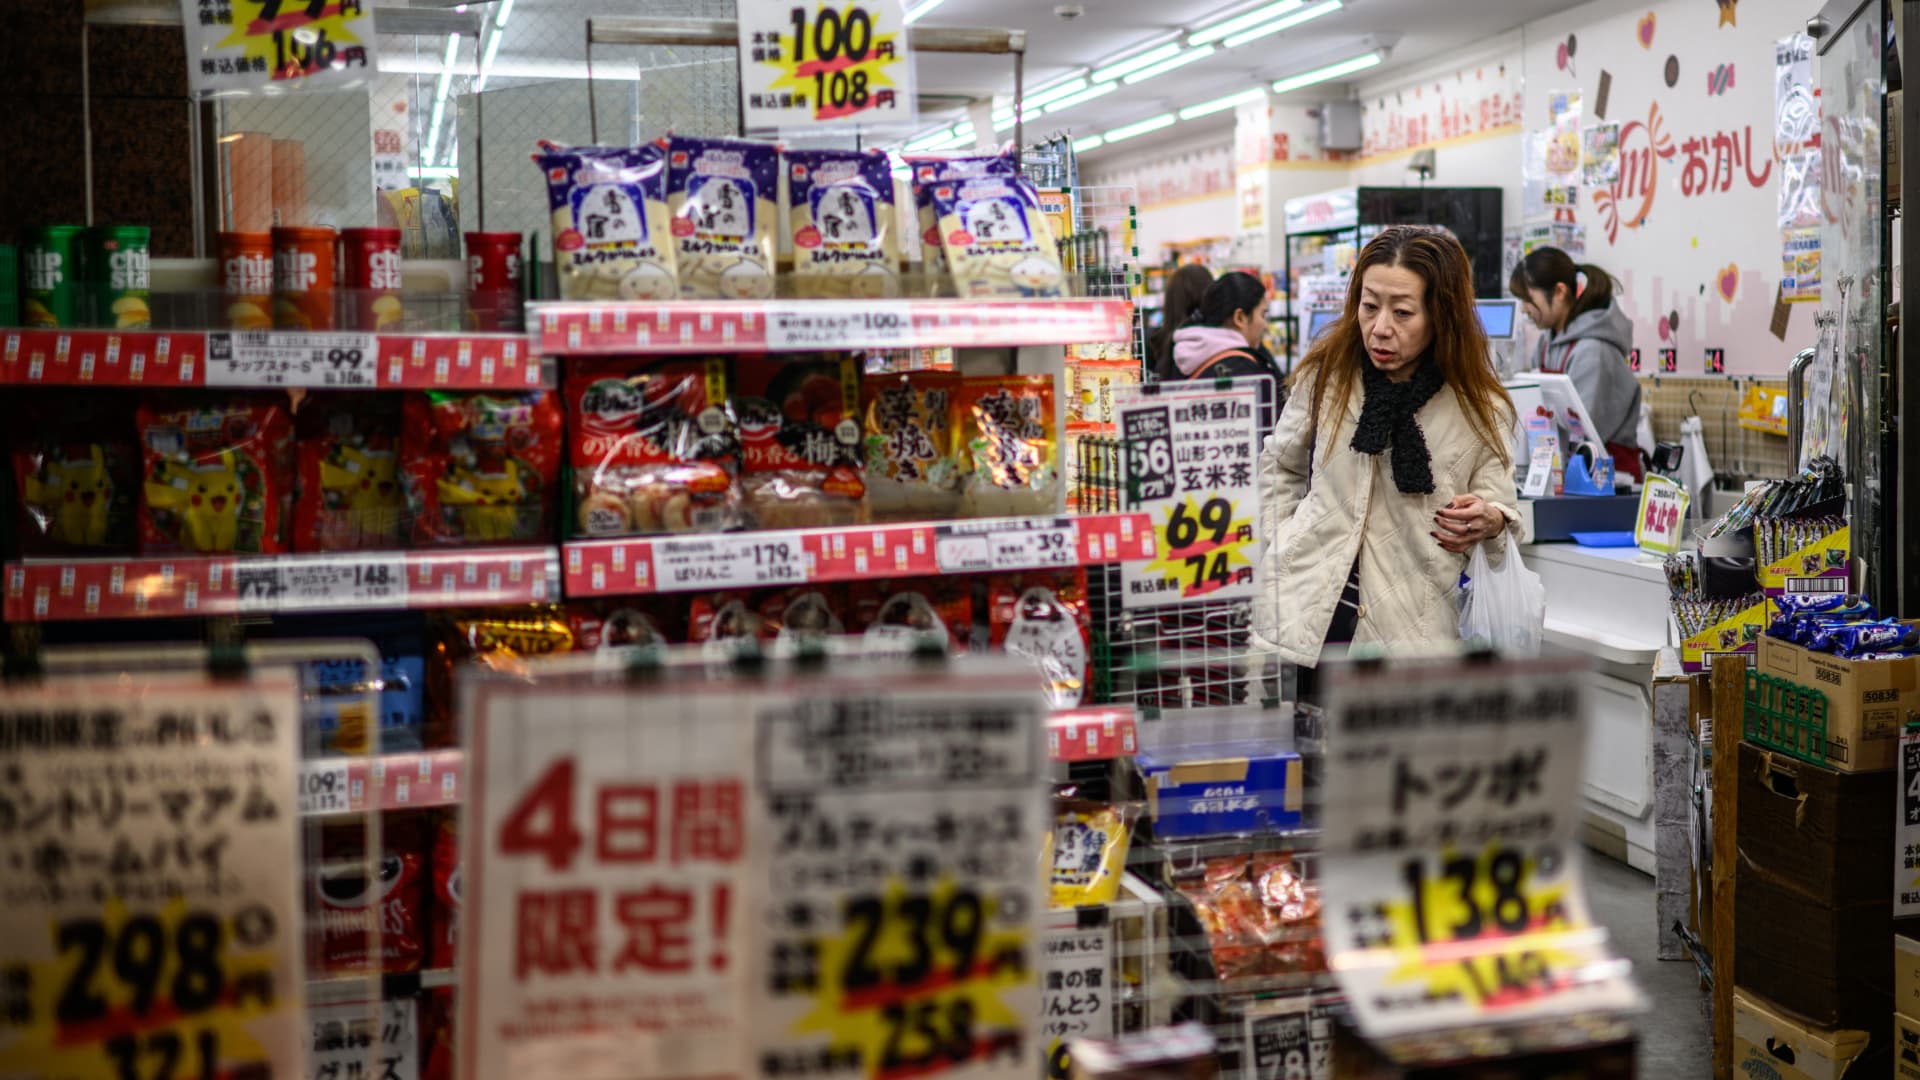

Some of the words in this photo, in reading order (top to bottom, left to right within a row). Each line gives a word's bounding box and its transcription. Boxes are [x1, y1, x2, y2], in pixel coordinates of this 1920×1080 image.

[791, 7, 871, 62] 100
[814, 70, 869, 110] 108
[1680, 125, 1772, 198] おかし
[328, 349, 363, 368] 99
[1176, 442, 1250, 463] 山形つや姫
[1181, 463, 1252, 491] 玄米茶
[1038, 532, 1065, 551] 39
[1166, 497, 1231, 549] 69
[754, 543, 789, 565] 179
[1131, 578, 1179, 594] 税込価格
[1185, 552, 1231, 589] 74
[354, 565, 390, 586] 148
[1864, 689, 1898, 702] 50836
[497, 752, 747, 873] 4日間
[1404, 847, 1529, 945] 138
[514, 882, 733, 983] 限定!
[842, 890, 985, 992] 239
[57, 912, 226, 1024] 298
[1047, 967, 1103, 991] 雪の宿
